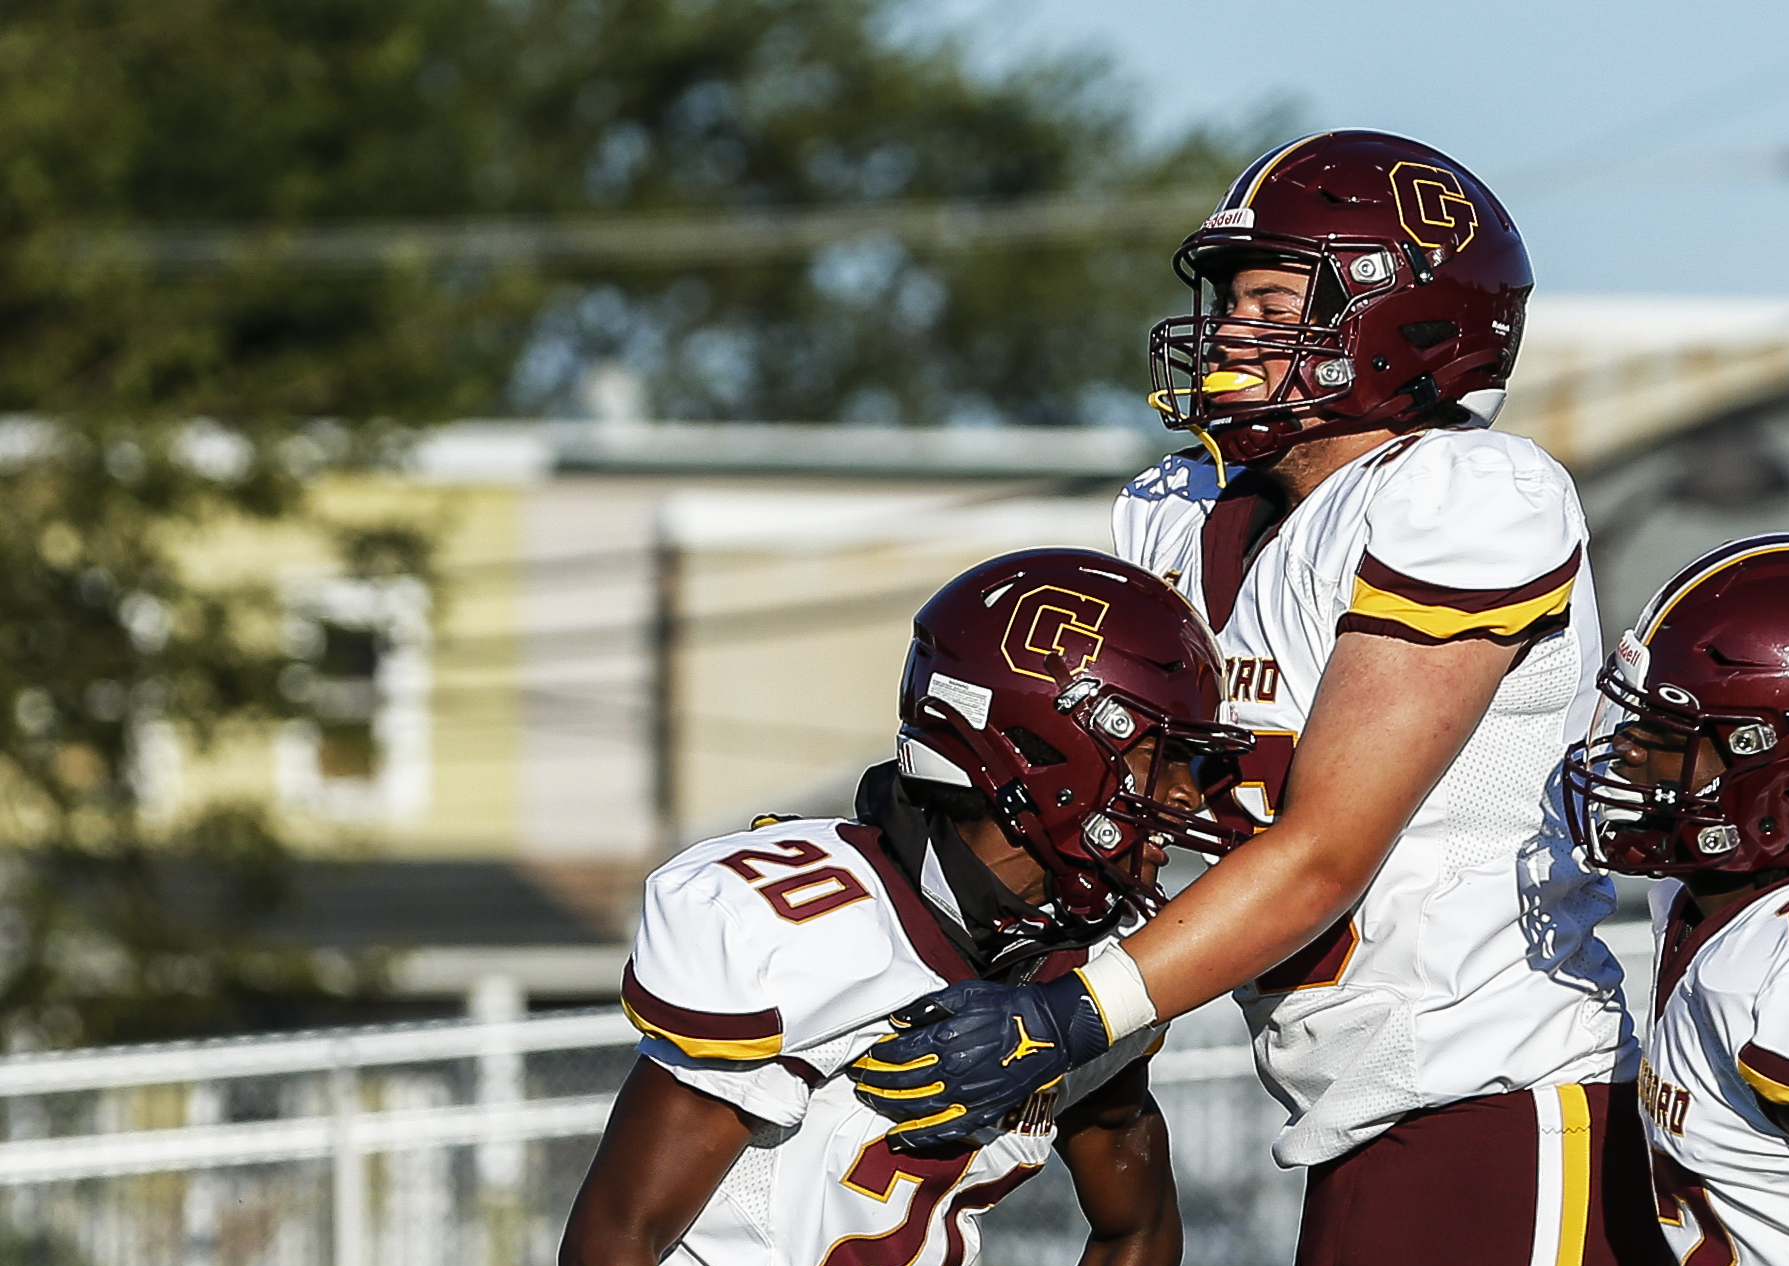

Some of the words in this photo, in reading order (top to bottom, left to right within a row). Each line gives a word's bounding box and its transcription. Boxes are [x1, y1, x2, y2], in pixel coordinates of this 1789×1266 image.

[1389, 160, 1479, 253] G
[1000, 584, 1110, 682] G
[713, 839, 874, 926] 20
